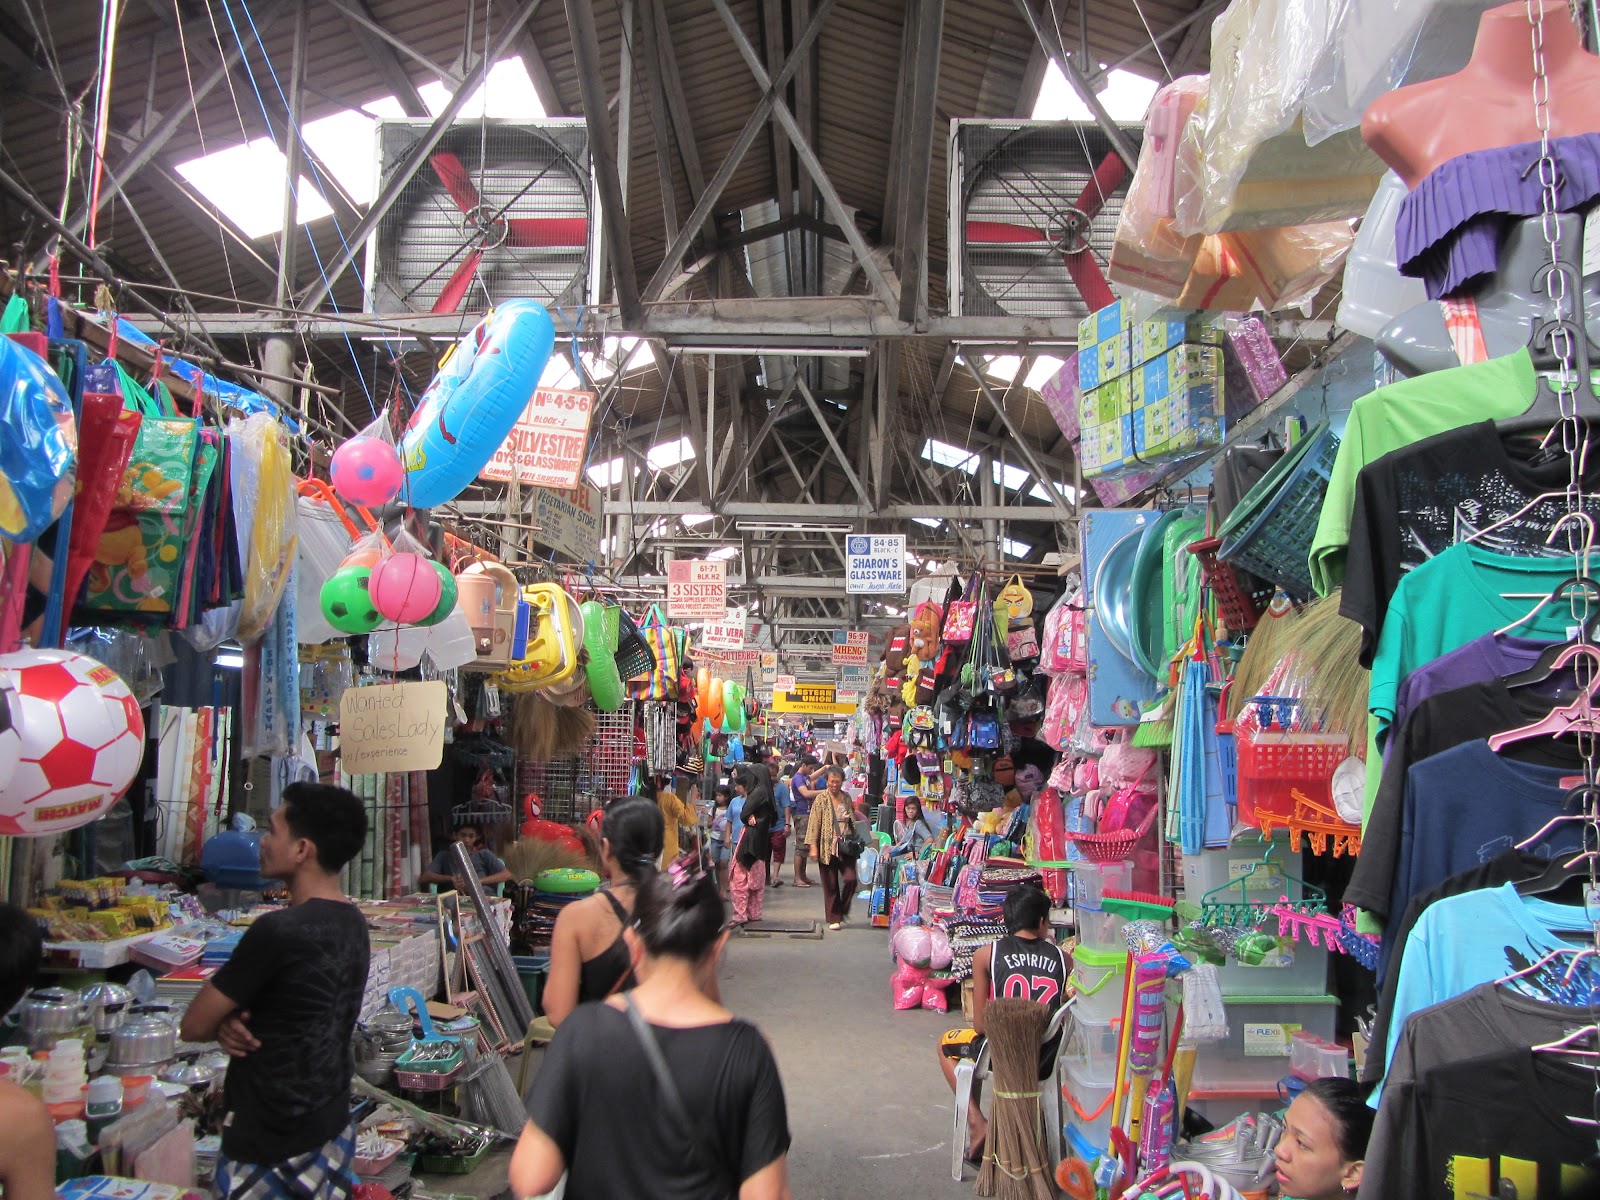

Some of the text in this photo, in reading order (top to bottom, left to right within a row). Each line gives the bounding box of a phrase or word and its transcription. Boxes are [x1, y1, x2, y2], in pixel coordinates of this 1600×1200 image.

[507, 428, 583, 459] SILVESTRE
[537, 488, 577, 519] VEGETARIAN
[577, 510, 597, 530] STORE
[873, 538, 899, 547] 84-85
[699, 565, 718, 573] 61-71
[852, 557, 898, 569] SHARON'S
[849, 570, 902, 580] GLASSWARE
[673, 583, 723, 597] 3 SISTERS
[714, 626, 723, 636] DE
[726, 627, 744, 639] VERA
[345, 685, 405, 714] Wanted
[789, 689, 833, 697] WESTERN
[1003, 953, 1057, 973] ESPIRITU
[1003, 973, 1059, 1005] 07
